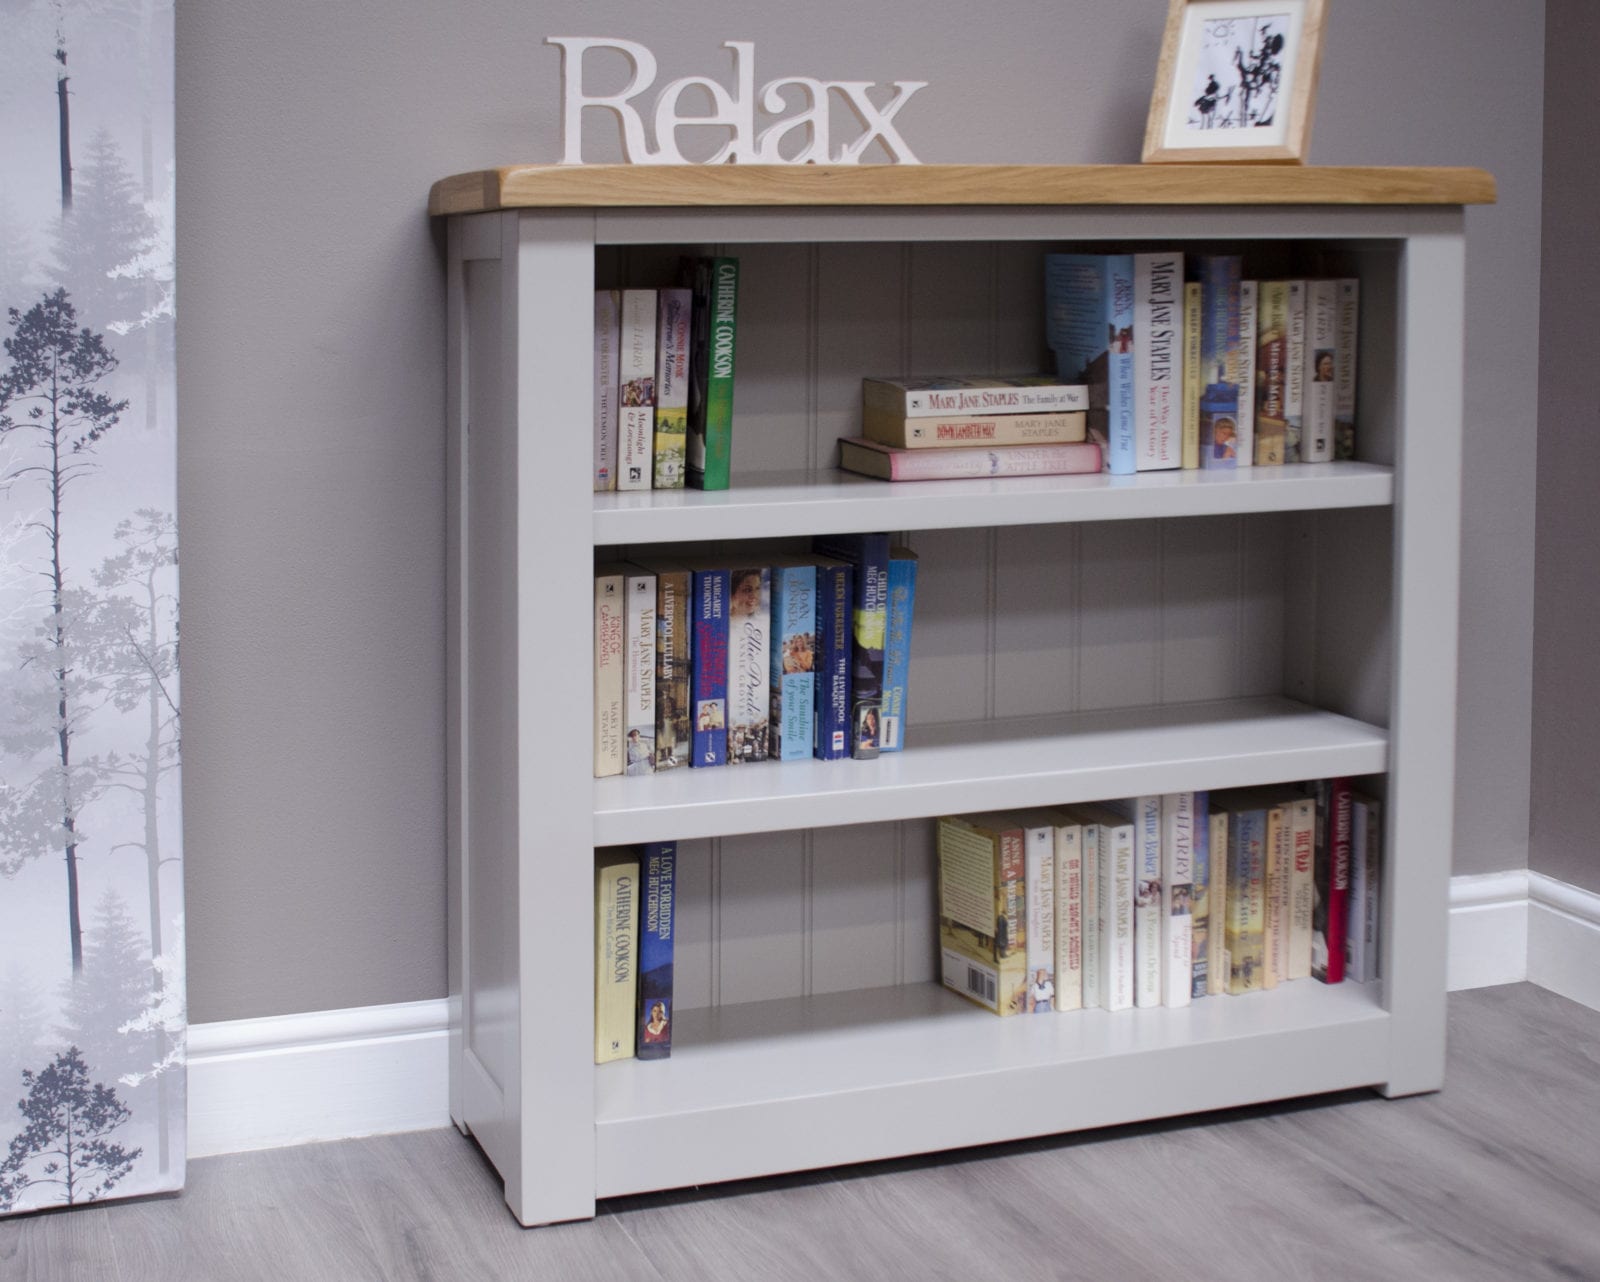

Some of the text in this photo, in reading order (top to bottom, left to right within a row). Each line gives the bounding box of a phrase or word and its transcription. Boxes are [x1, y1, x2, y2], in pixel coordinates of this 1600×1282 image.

[543, 36, 929, 165] Relax
[716, 265, 736, 323] CATHERINE
[1113, 273, 1124, 318] JONKER
[1342, 301, 1355, 328] MARY
[1148, 262, 1175, 381] MARY JANE STAPLES
[1240, 305, 1252, 332] MARY
[1316, 296, 1327, 342] HARRY
[601, 338, 610, 386] FORRESTER
[632, 327, 646, 370] HARRY
[675, 322, 686, 378] CONNIE MONK
[714, 326, 733, 378] COOKSON
[1240, 335, 1251, 356] JANE
[1291, 309, 1303, 403] MARY JANE STAPLES
[664, 352, 676, 397] Memories
[1240, 359, 1251, 397] STAPLES
[1268, 342, 1280, 416] MERSEY MAIDS
[929, 393, 956, 410] MARY
[958, 392, 981, 411] JANE
[982, 391, 1020, 406] STAPLES
[1023, 395, 1036, 404] The
[1037, 394, 1058, 406] Family
[1068, 392, 1080, 402] War
[1015, 419, 1067, 430] MARY JANE
[1119, 358, 1132, 452] When Wishes Come True
[1146, 385, 1158, 459] Year of Victory
[1160, 385, 1170, 461] The Way Ahead
[600, 395, 608, 462] THE LEMON TREE
[626, 423, 636, 465] Lovesongs
[637, 412, 646, 455] Moonlight
[1021, 428, 1060, 438] STAPLES
[703, 576, 712, 620] THORNTON
[712, 576, 722, 619] MARGARET
[788, 579, 800, 629] JONKER
[798, 588, 810, 620] JOAN
[866, 566, 878, 640] MEG HUTCHINSON
[877, 571, 888, 601] CHILD
[664, 590, 674, 640] LIVERPOOL
[834, 572, 844, 650] HELEN FORRESTER
[599, 604, 609, 668] CAMBERWELL
[610, 616, 621, 655] KING OF
[638, 608, 654, 711] MARY JANE STAPLES
[629, 636, 640, 693] The Homecoming
[663, 641, 674, 680] LULLABY
[738, 638, 746, 717] ANNIE GROVES
[744, 623, 763, 716] Ellie Pride
[787, 679, 798, 743] of your Smile
[798, 678, 809, 742] The Sunshine
[832, 675, 840, 708] BASQUE
[838, 658, 846, 724] THE LIVERPOOL
[882, 690, 892, 712] MONK
[890, 687, 902, 716] CONNIE
[601, 710, 609, 752] STAPLES
[609, 701, 619, 760] MARY JANE
[1144, 801, 1158, 876] Anne Baker
[1336, 792, 1350, 842] CATHERINE
[660, 856, 672, 882] LOVE
[1001, 837, 1011, 870] BAKER
[1012, 837, 1020, 865] ANNE
[1117, 847, 1130, 875] MARY
[1177, 816, 1190, 880] HARRY
[1296, 830, 1310, 873] THE TRAP
[1334, 844, 1348, 890] COOKSON
[647, 856, 660, 932] MEG HUTCHINSON
[1116, 877, 1130, 898] JANE
[1250, 840, 1260, 916] ANNE BAKER
[606, 919, 614, 936] Black
[658, 884, 672, 940] FORBIDDEN
[1006, 870, 1018, 945] A MERSEY DUET
[1039, 857, 1053, 952] MARY JANE STAPLES
[1116, 900, 1130, 938] STAPLES
[606, 937, 614, 959] Candle
[614, 877, 632, 984] CATHERINE COOKSON
